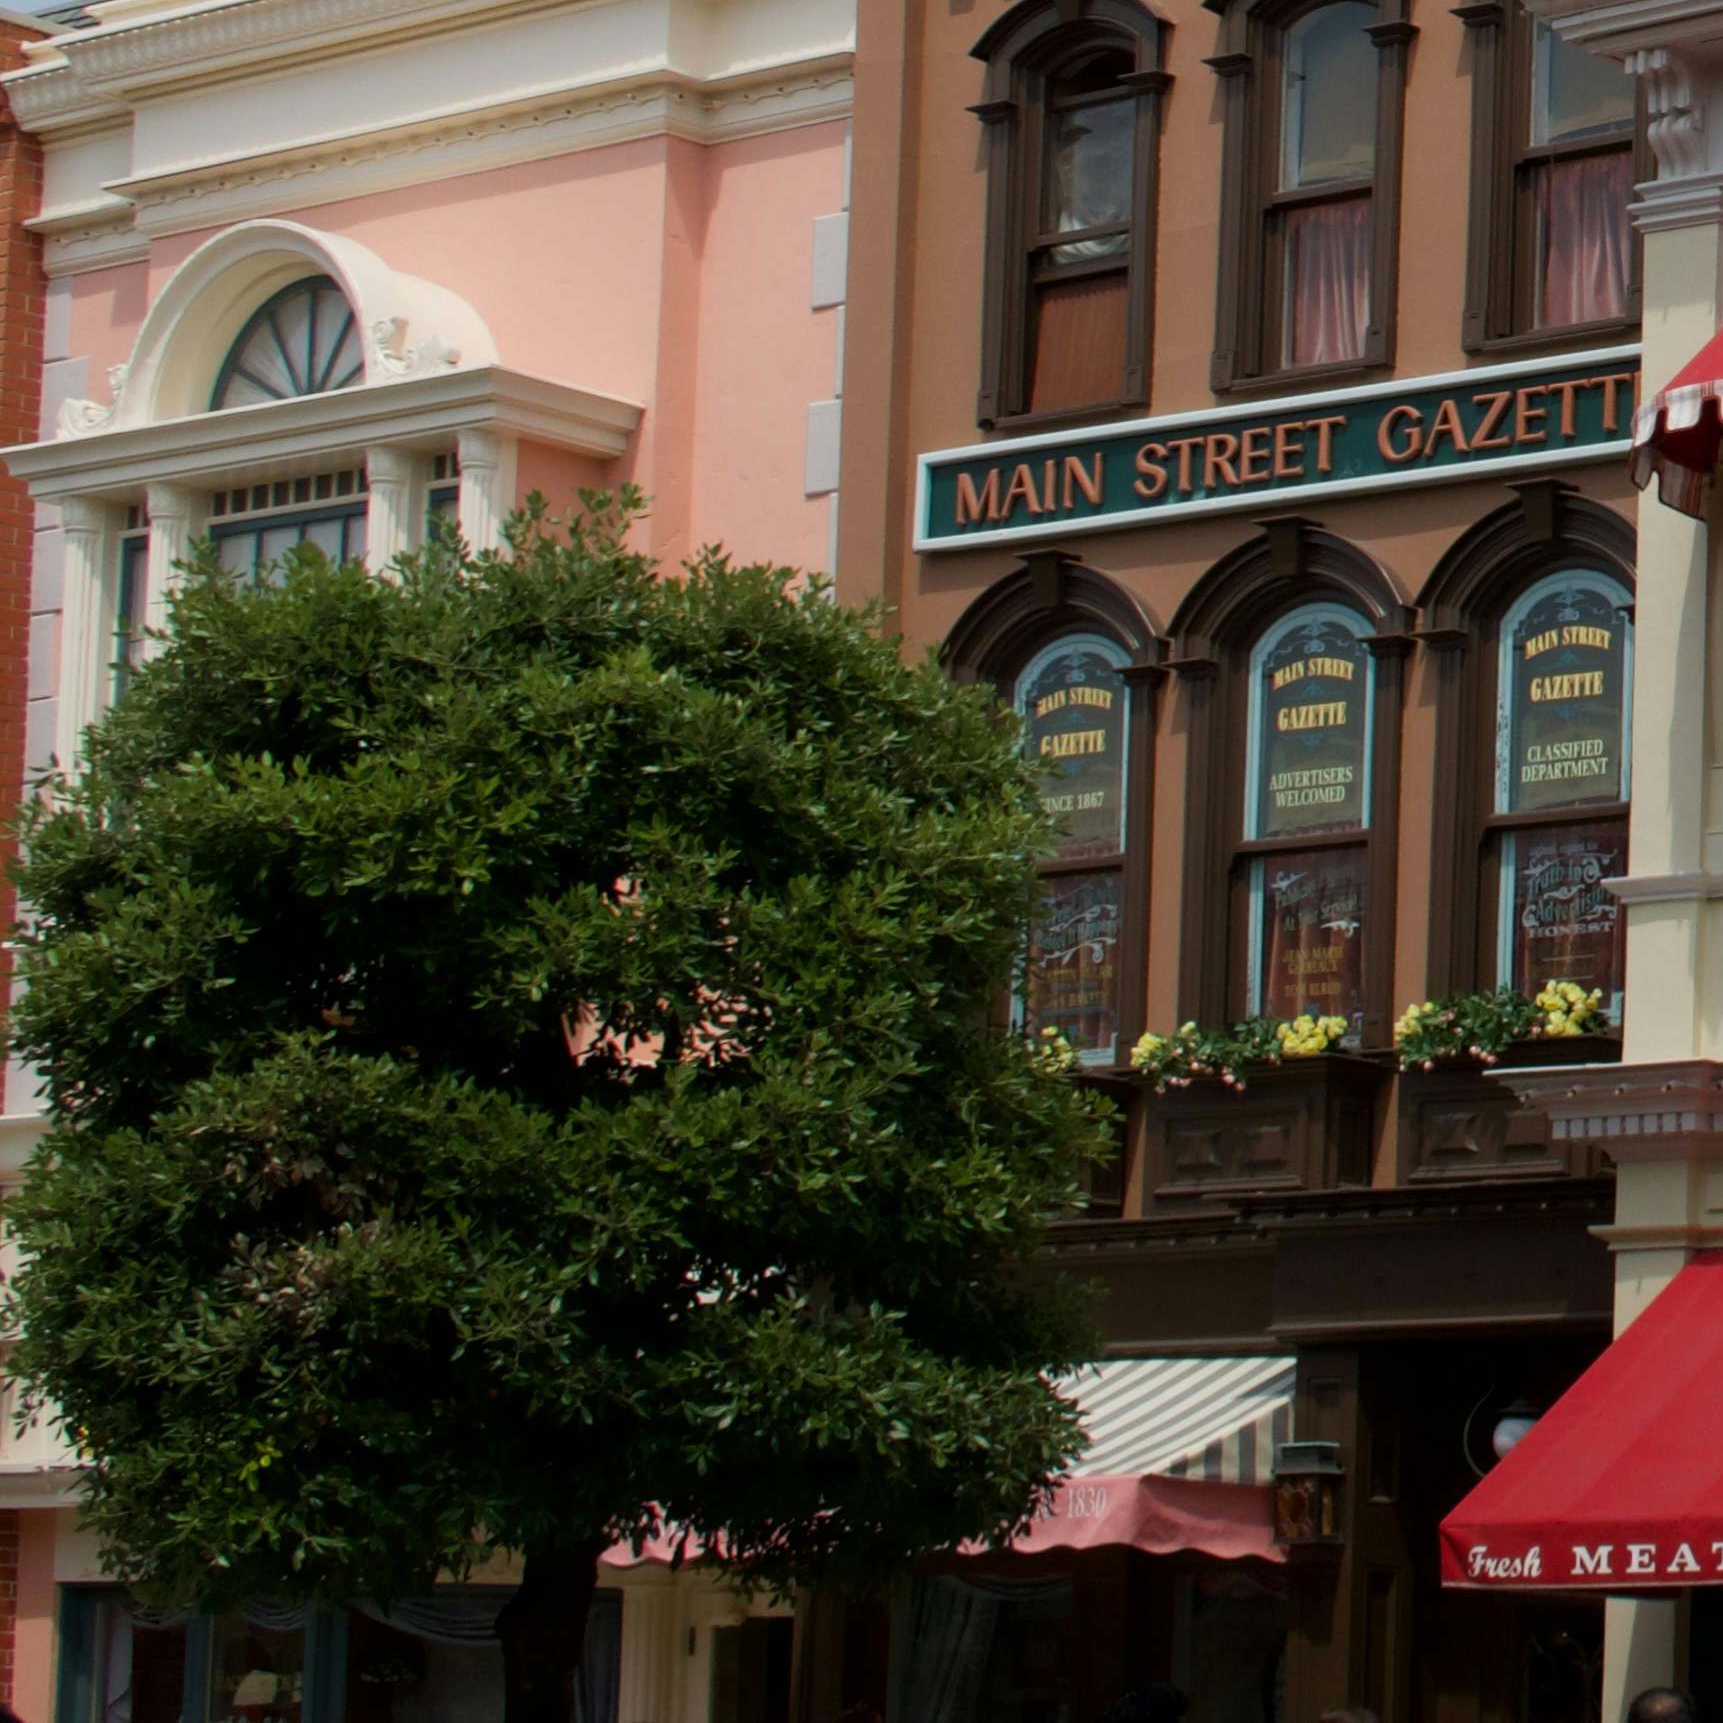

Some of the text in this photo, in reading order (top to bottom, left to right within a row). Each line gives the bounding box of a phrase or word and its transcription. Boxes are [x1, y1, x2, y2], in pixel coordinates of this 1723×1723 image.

[955, 370, 1642, 526] MAIN STREET GAZETT
[1524, 625, 1612, 660] MAIN STREET
[1272, 657, 1355, 692] MAIN STREET
[1530, 671, 1604, 702] GAZETTE
[1068, 686, 1113, 710] STREET
[1278, 701, 1347, 732] GAZETTE
[1040, 729, 1106, 758] GAZETTE
[1527, 739, 1604, 763] CLASSIFIED
[1269, 766, 1353, 790] ADVERTISERS
[1521, 757, 1609, 782] DEPARTMENT
[1077, 791, 1105, 810] 1867
[1276, 785, 1346, 808] WELCOMED
[1528, 860, 1564, 898] Truth
[1529, 921, 1614, 939] HONEST
[1066, 1486, 1107, 1518] 1830
[1467, 1544, 1543, 1579] Fresh
